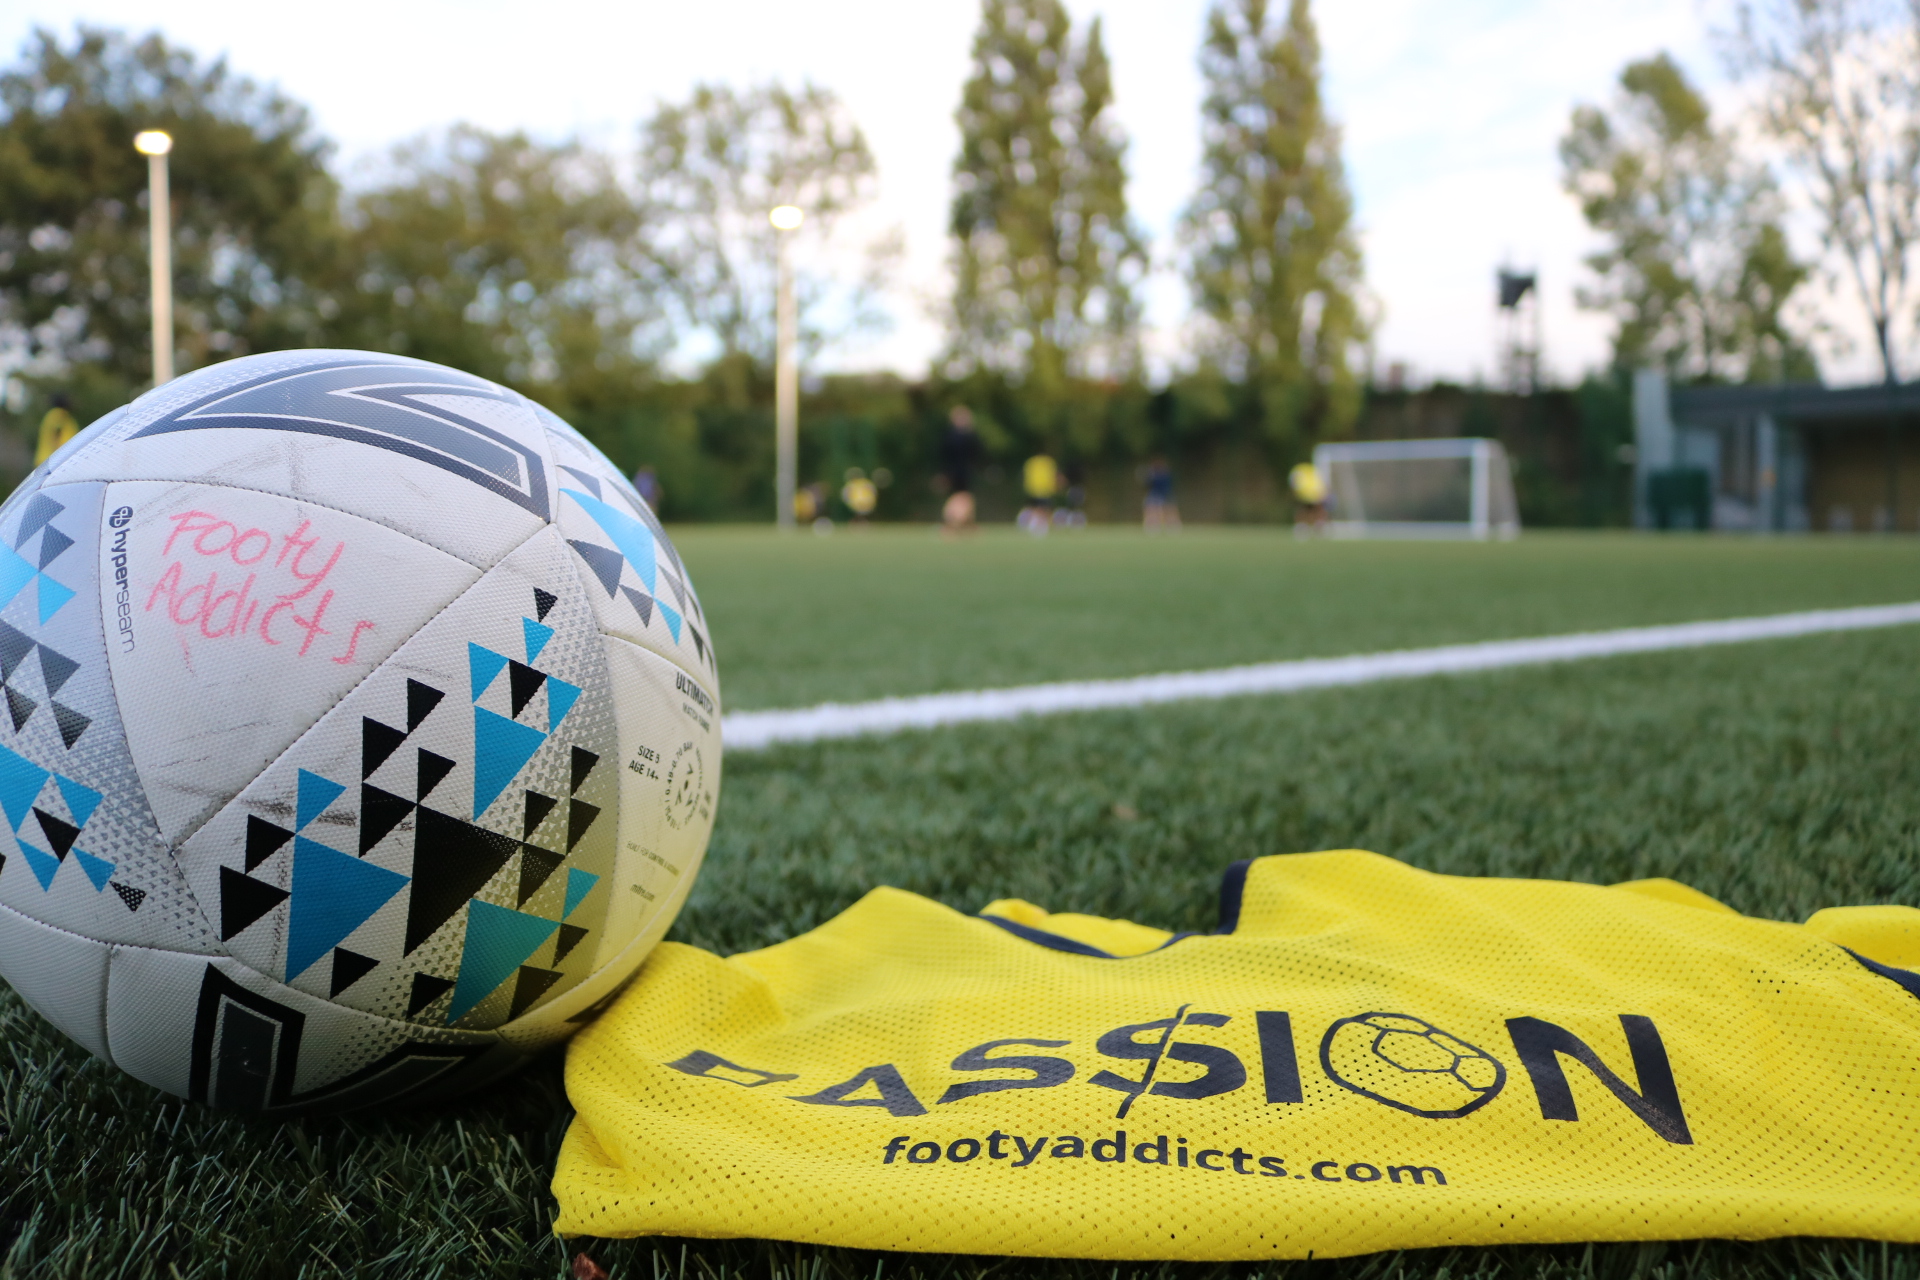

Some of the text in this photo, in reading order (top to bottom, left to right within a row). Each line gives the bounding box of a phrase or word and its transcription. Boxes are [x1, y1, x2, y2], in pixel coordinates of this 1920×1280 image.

[108, 527, 137, 654] hyperseam
[144, 560, 375, 665] Addicts
[628, 759, 659, 781] AGE 14+
[637, 745, 661, 764] SIZE 5
[882, 1129, 1448, 1186] footyaddicts.com
